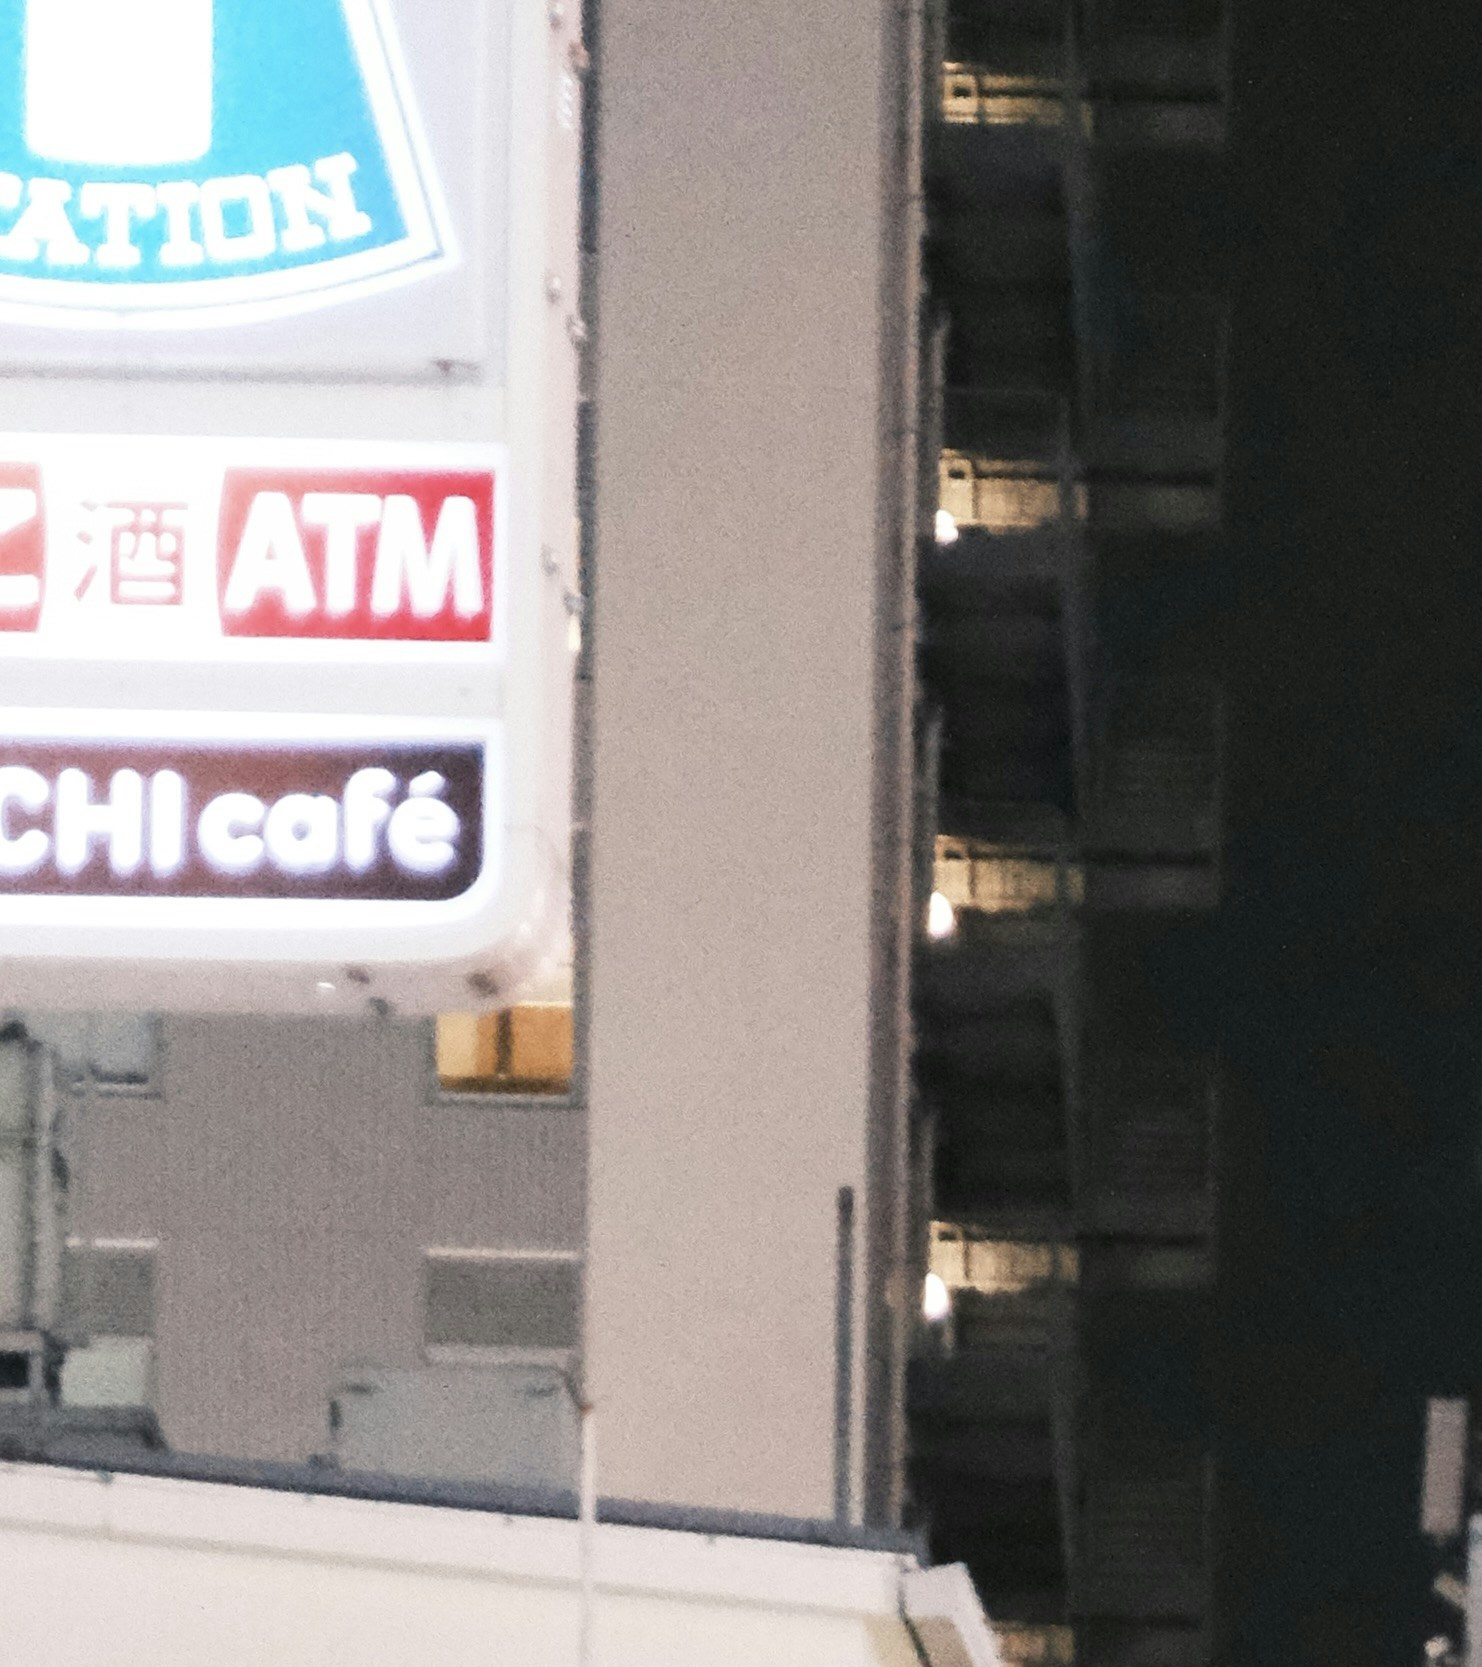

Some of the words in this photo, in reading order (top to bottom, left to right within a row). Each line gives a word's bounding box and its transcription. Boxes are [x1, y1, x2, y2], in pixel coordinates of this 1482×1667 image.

[74, 499, 189, 606] 酒
[222, 491, 487, 621] ATM
[199, 767, 461, 874] café
